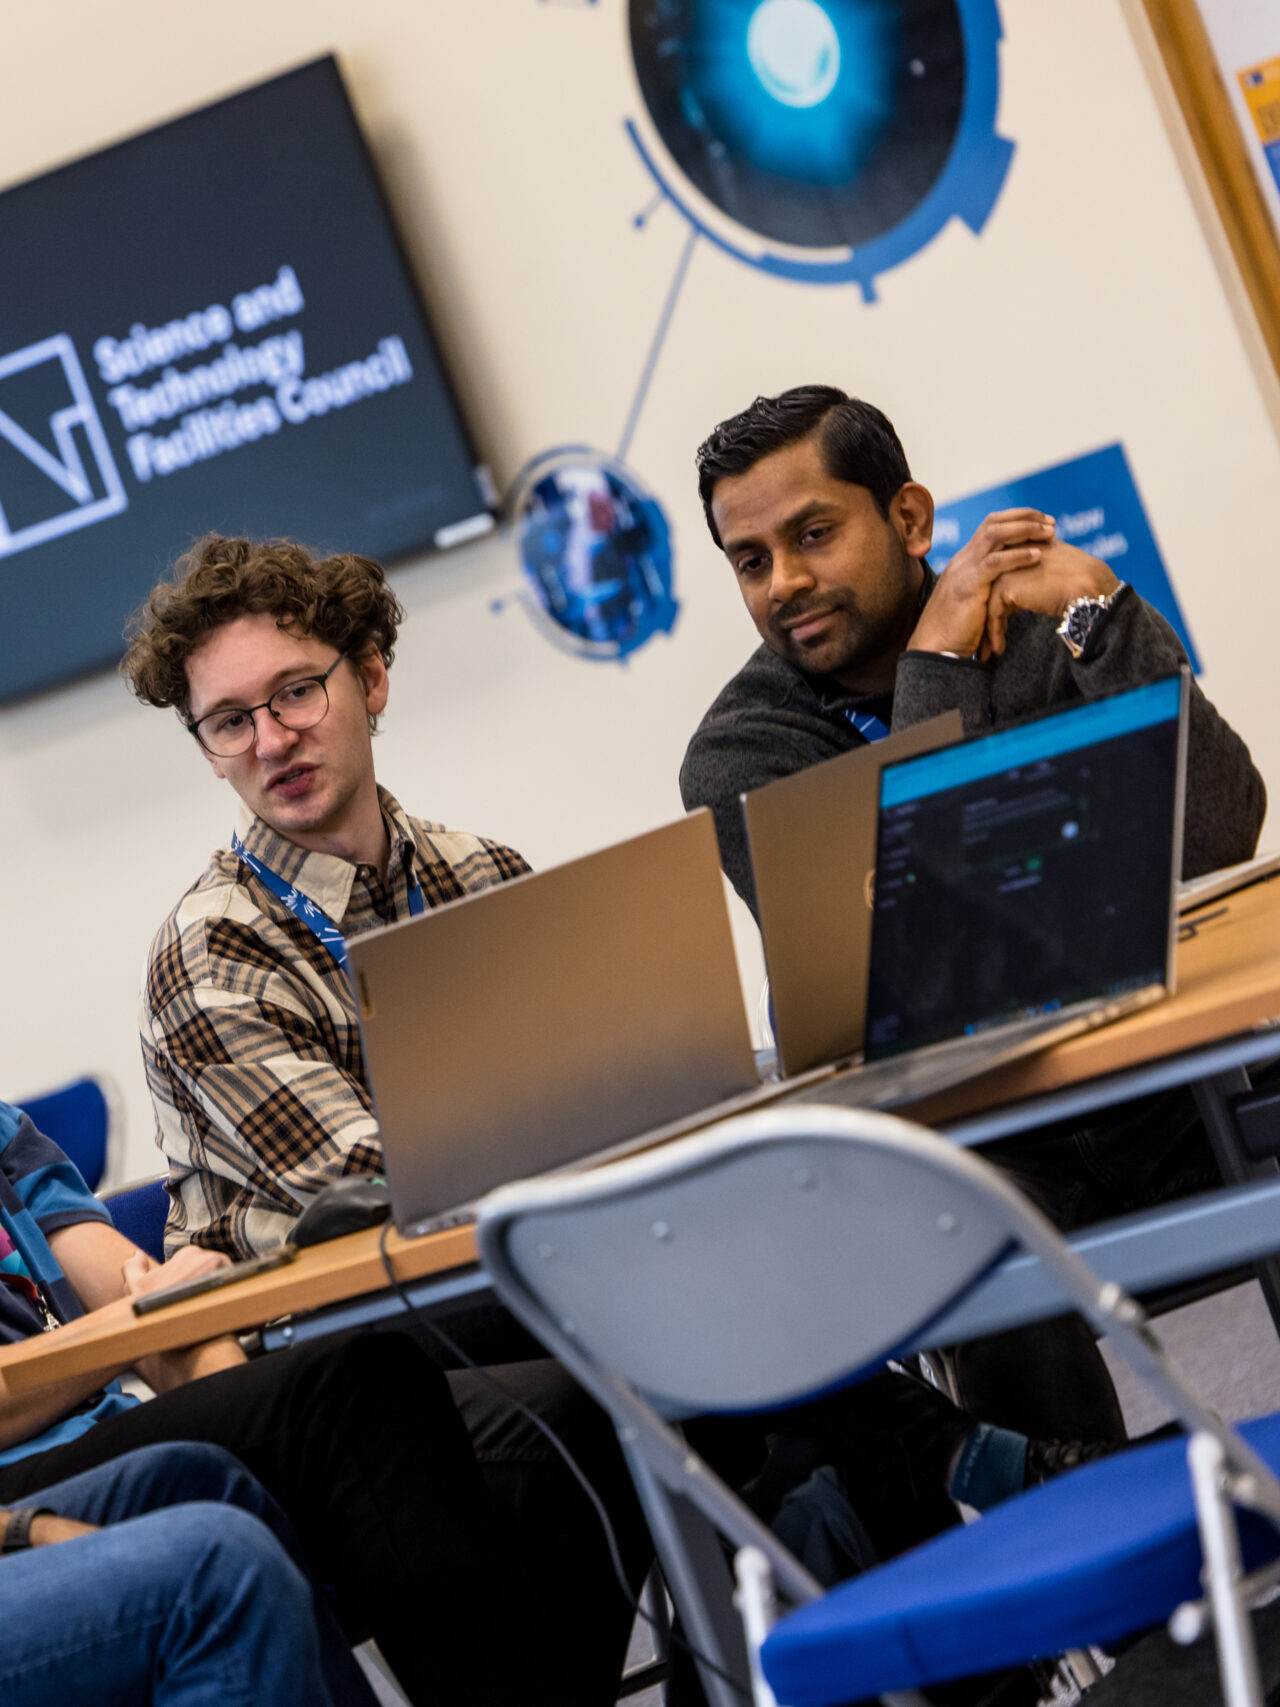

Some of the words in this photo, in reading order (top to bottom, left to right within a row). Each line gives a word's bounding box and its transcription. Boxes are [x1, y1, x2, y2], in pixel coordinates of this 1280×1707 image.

[93, 302, 234, 384] Science
[231, 264, 306, 333] and
[107, 328, 306, 432] Technology
[125, 395, 283, 484] Facilities
[274, 332, 414, 425] Council
